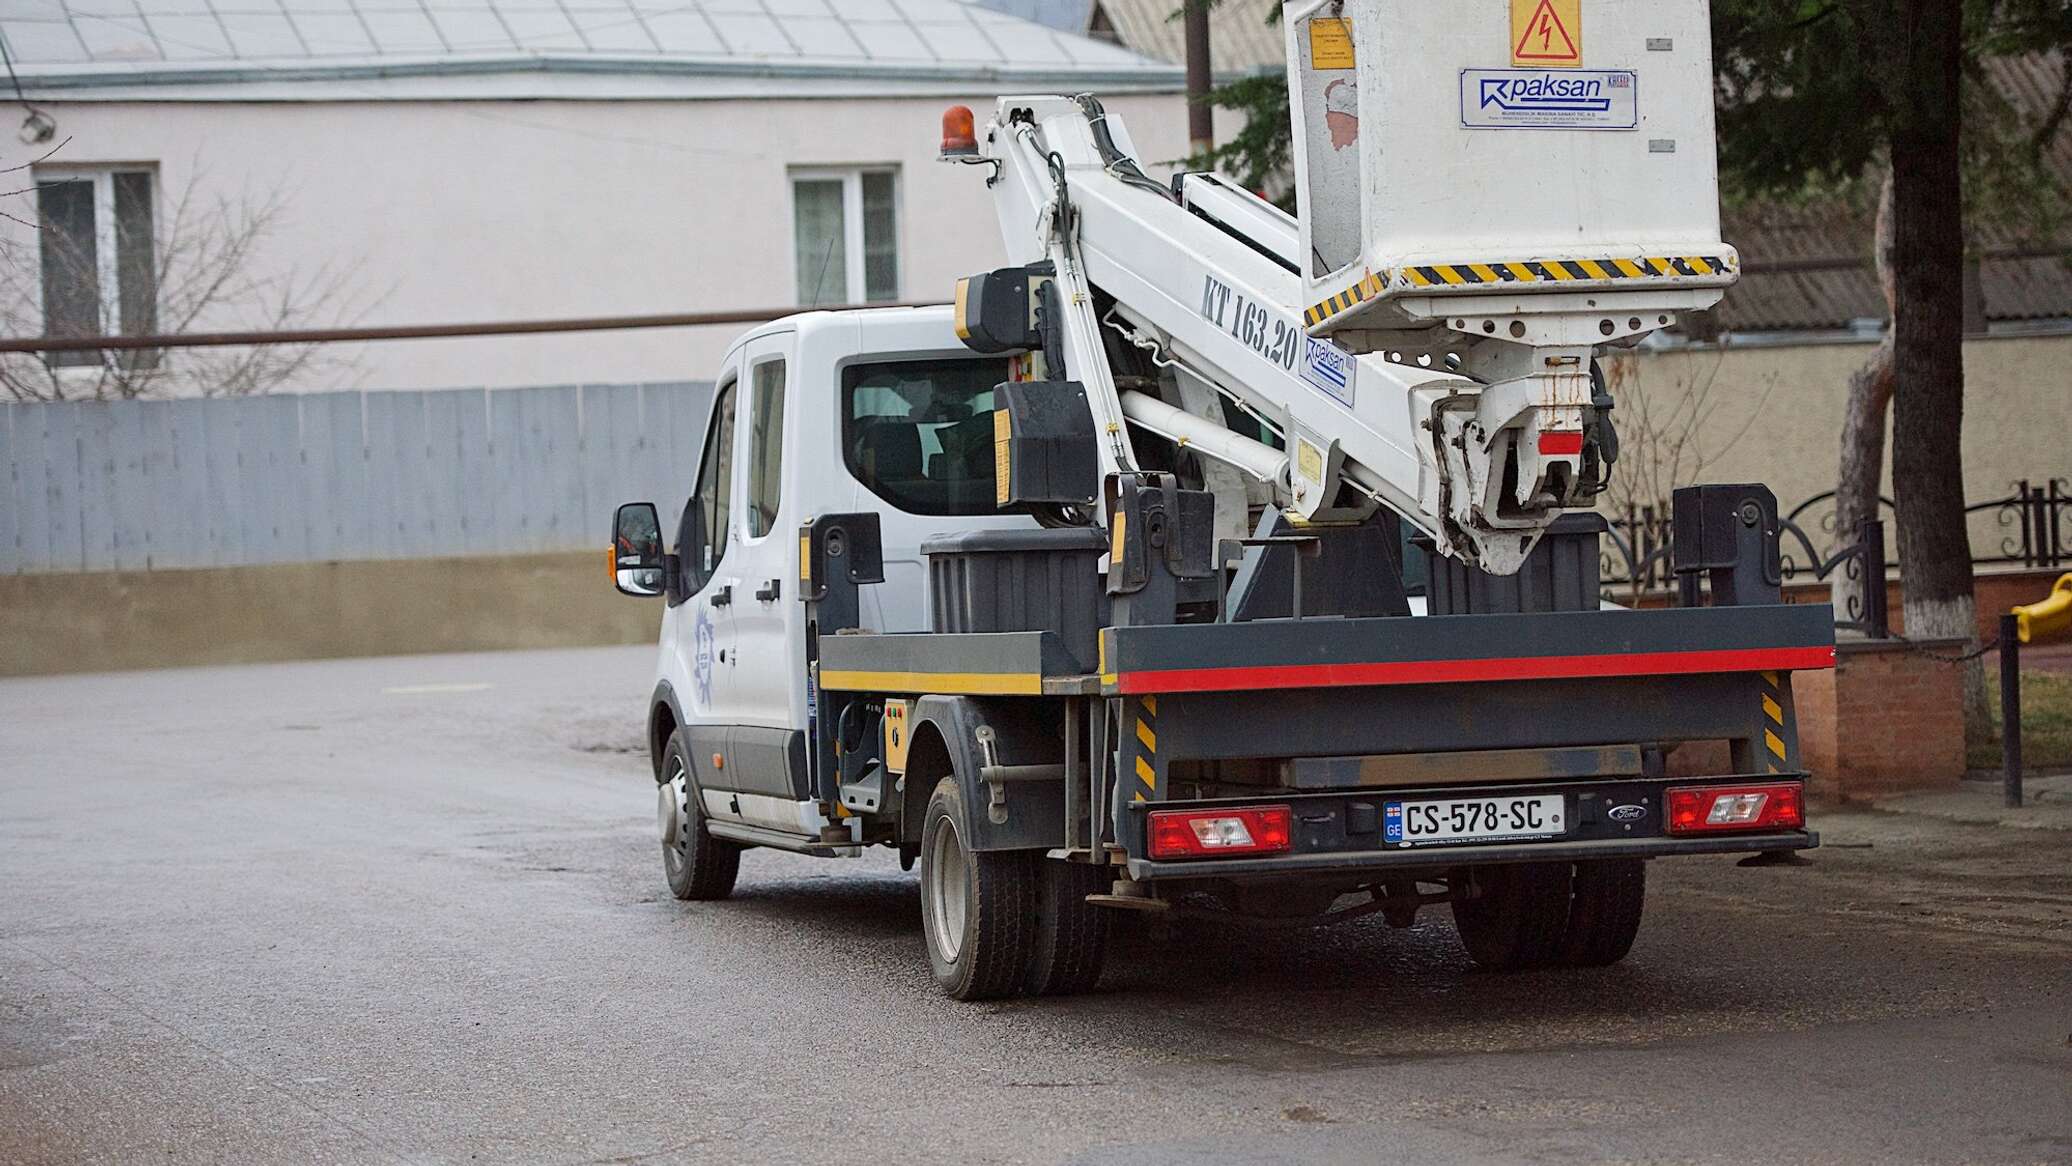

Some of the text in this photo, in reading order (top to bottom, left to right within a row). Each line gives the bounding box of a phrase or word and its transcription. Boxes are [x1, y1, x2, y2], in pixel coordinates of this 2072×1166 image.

[1510, 74, 1600, 101] paksan
[1202, 274, 1298, 371] KT 163.20
[1315, 343, 1345, 373] paksan
[1387, 824, 1401, 836] GE
[1407, 800, 1543, 834] CS-578-SC
